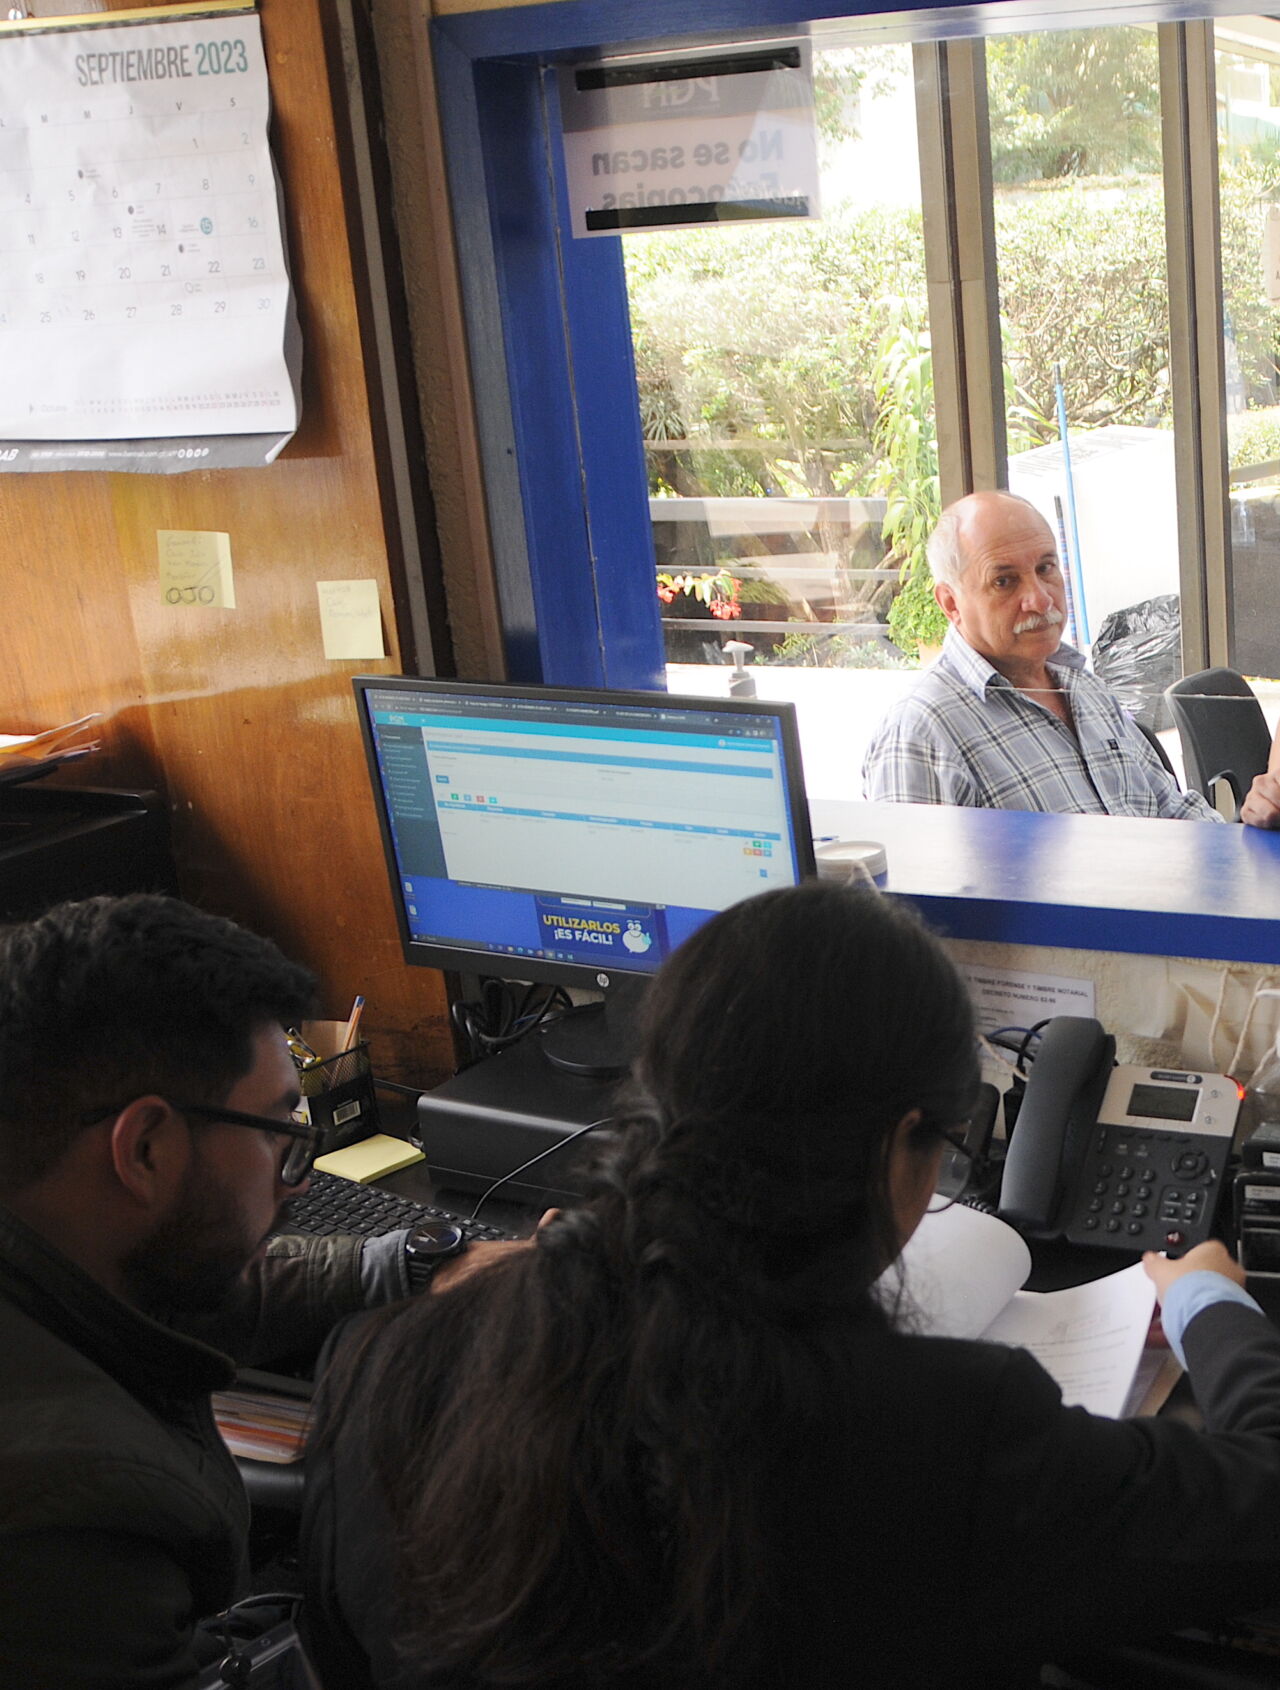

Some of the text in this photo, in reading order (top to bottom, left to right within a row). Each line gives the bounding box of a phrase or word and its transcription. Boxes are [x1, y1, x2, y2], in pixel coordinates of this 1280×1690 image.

[75, 39, 249, 87] SEPTIEMBRE 2023
[176, 102, 182, 111] V
[230, 98, 235, 107] S
[166, 585, 215, 605] OJO
[543, 914, 620, 934] UTILIZARLOS
[554, 928, 613, 945] ¡ES FÁCIL!
